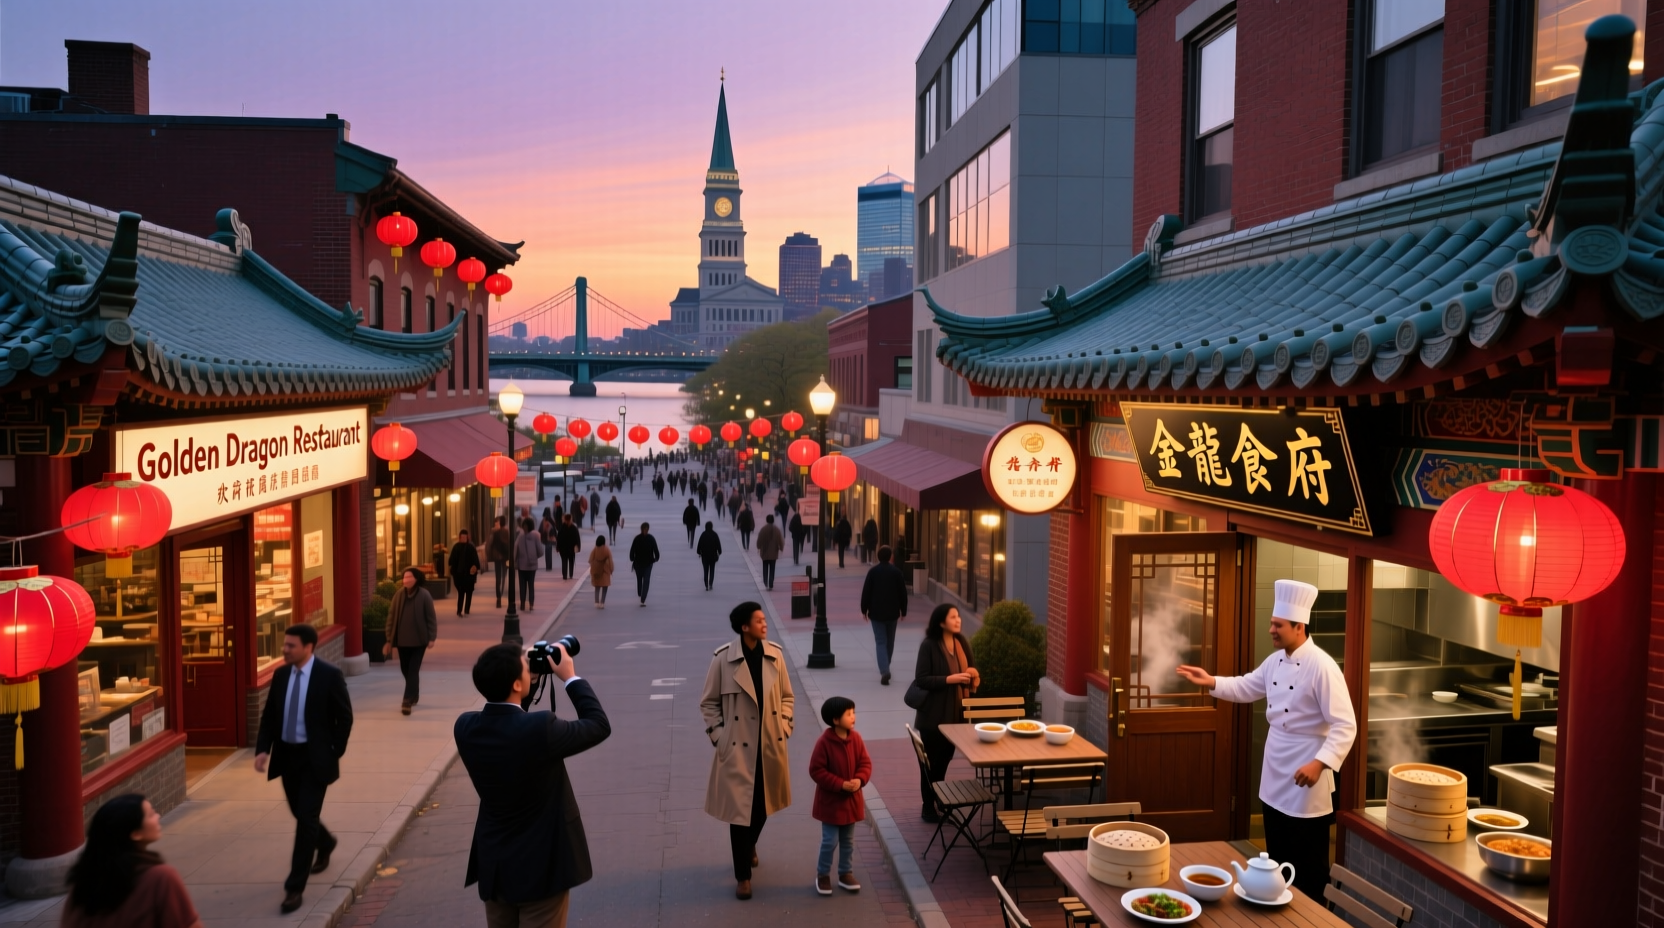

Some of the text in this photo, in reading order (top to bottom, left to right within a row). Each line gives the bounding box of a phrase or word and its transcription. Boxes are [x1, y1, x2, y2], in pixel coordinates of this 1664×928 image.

[138, 420, 361, 482] Golden Dragon Restaurant
[1149, 418, 1332, 506] 金龍食府
